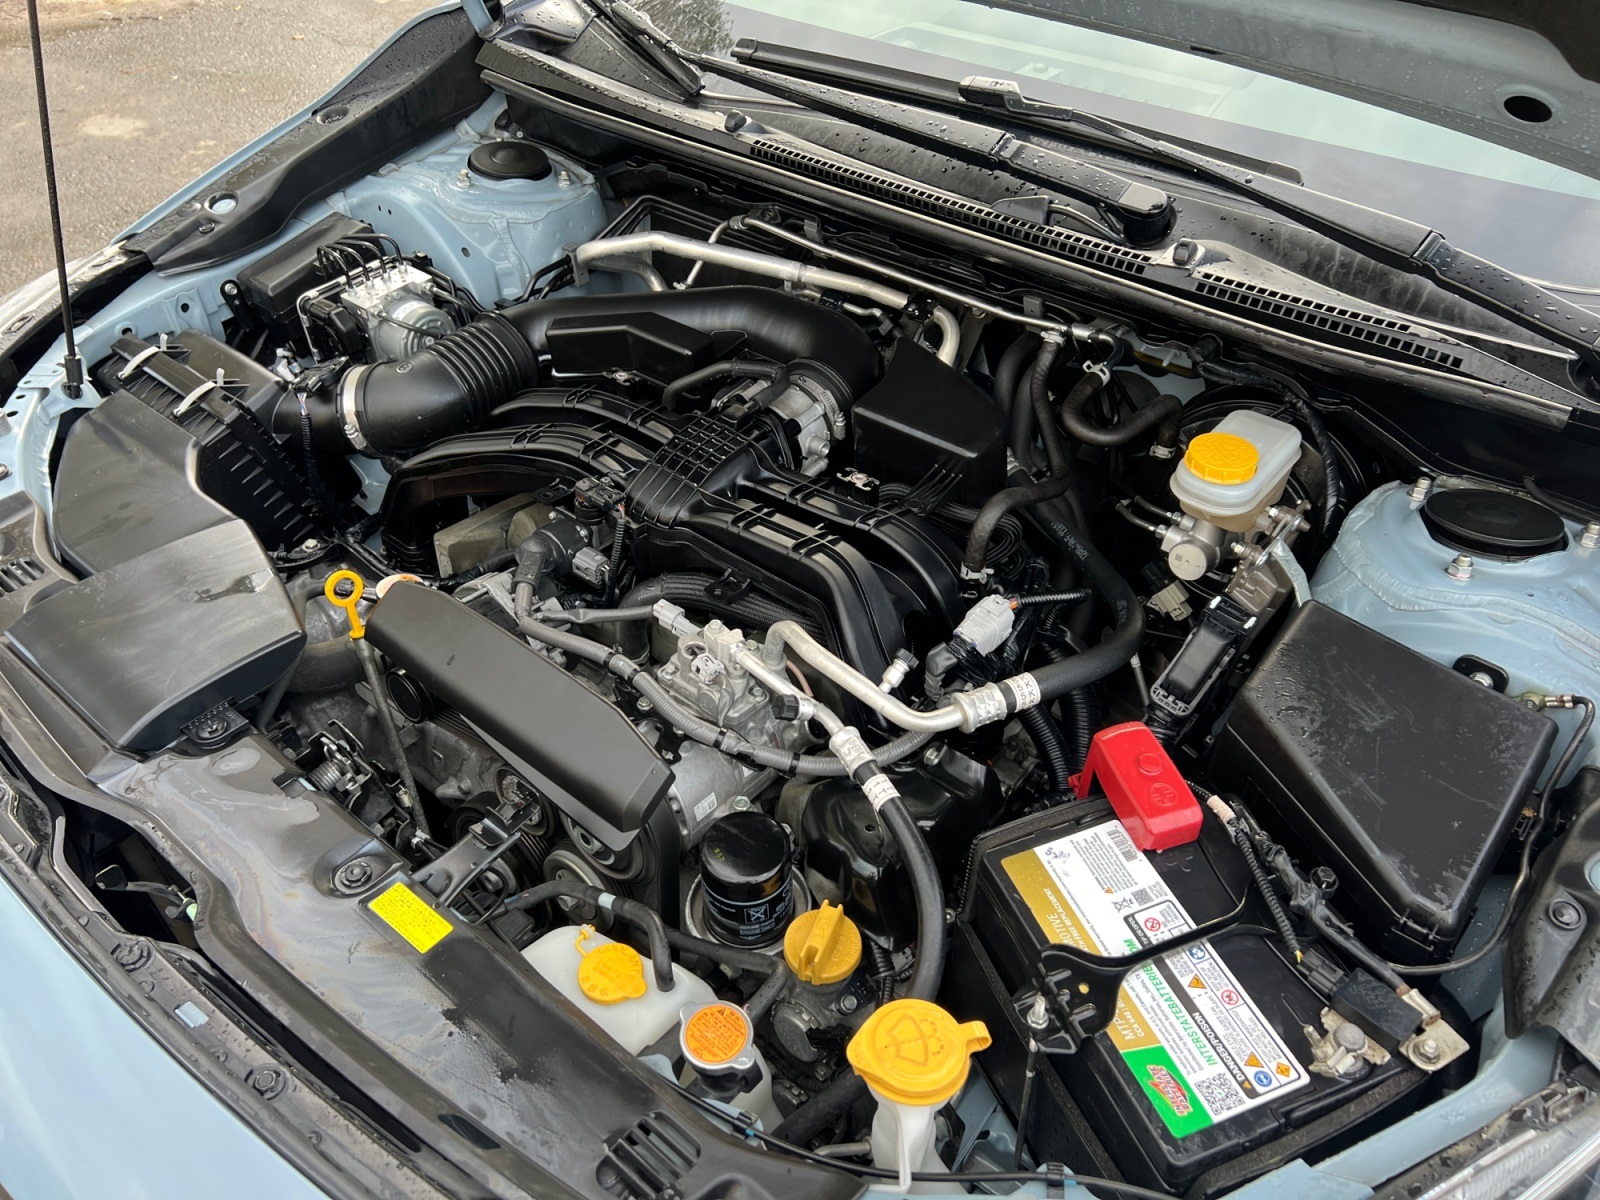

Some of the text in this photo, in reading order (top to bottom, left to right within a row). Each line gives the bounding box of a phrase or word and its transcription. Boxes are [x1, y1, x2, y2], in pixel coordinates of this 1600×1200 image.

[1042, 886, 1072, 925] REPLACEMENT
[1067, 924, 1081, 940] FREE
[1192, 1011, 1245, 1081] DANGER/POISON
[1148, 1066, 1184, 1113] INTERSTATE
[1156, 1066, 1189, 1108] BATTERIES
